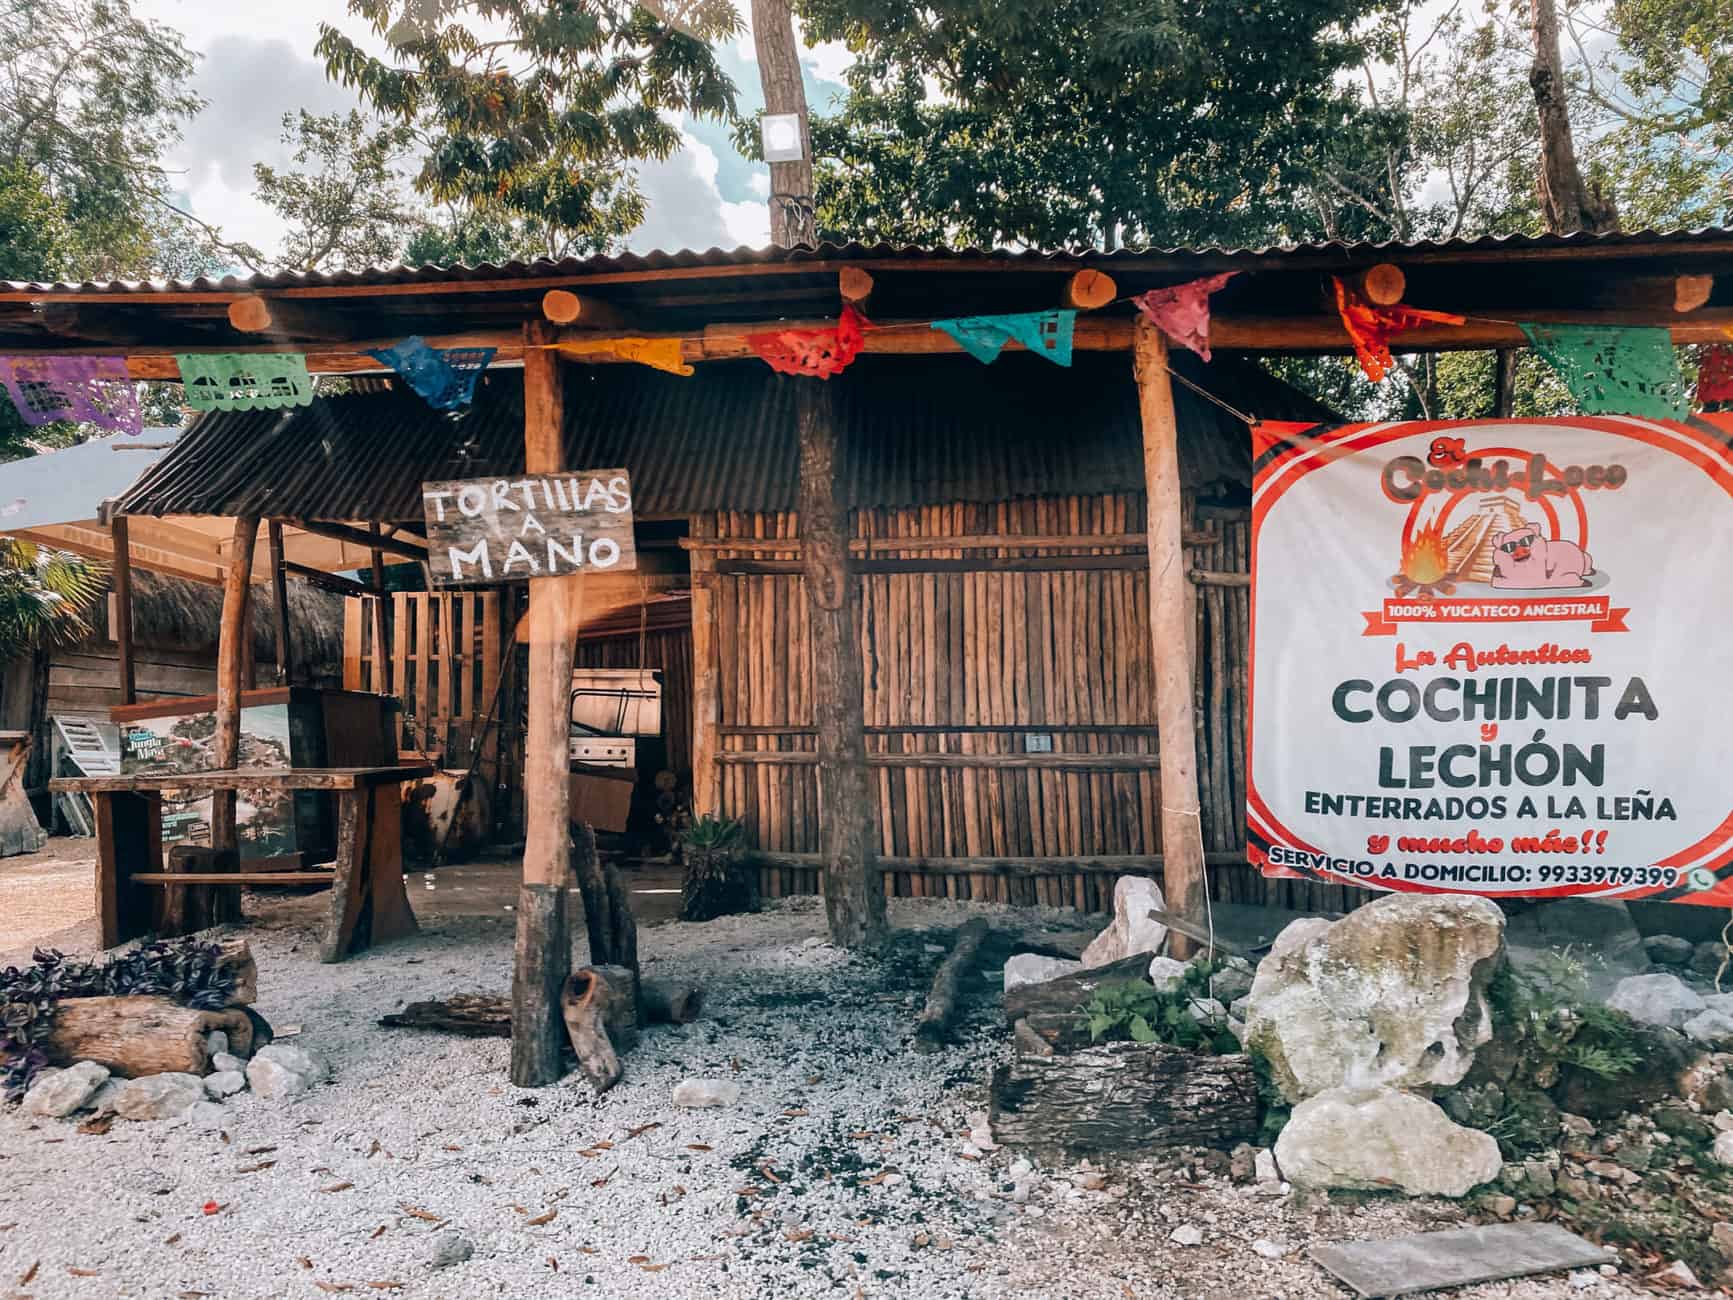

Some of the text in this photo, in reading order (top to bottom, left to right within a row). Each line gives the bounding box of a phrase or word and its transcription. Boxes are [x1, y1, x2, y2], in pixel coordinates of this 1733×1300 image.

[423, 477, 631, 522] TORTILLAS
[521, 513, 546, 537] A
[448, 536, 620, 580] MANO
[1387, 603, 1603, 618] 1000% YUCATECO ANCESTRAL
[1395, 641, 1593, 673] La Autentica
[1332, 676, 1659, 723] COCHINITA
[1378, 728, 1605, 789] LECHÓN
[1304, 789, 1677, 821] ENTERRADOS A LA LEÑA
[1366, 829, 1609, 854] y mucho más!!
[1269, 847, 1677, 886] SERVICIO A DOMICILIO: 9933979399
